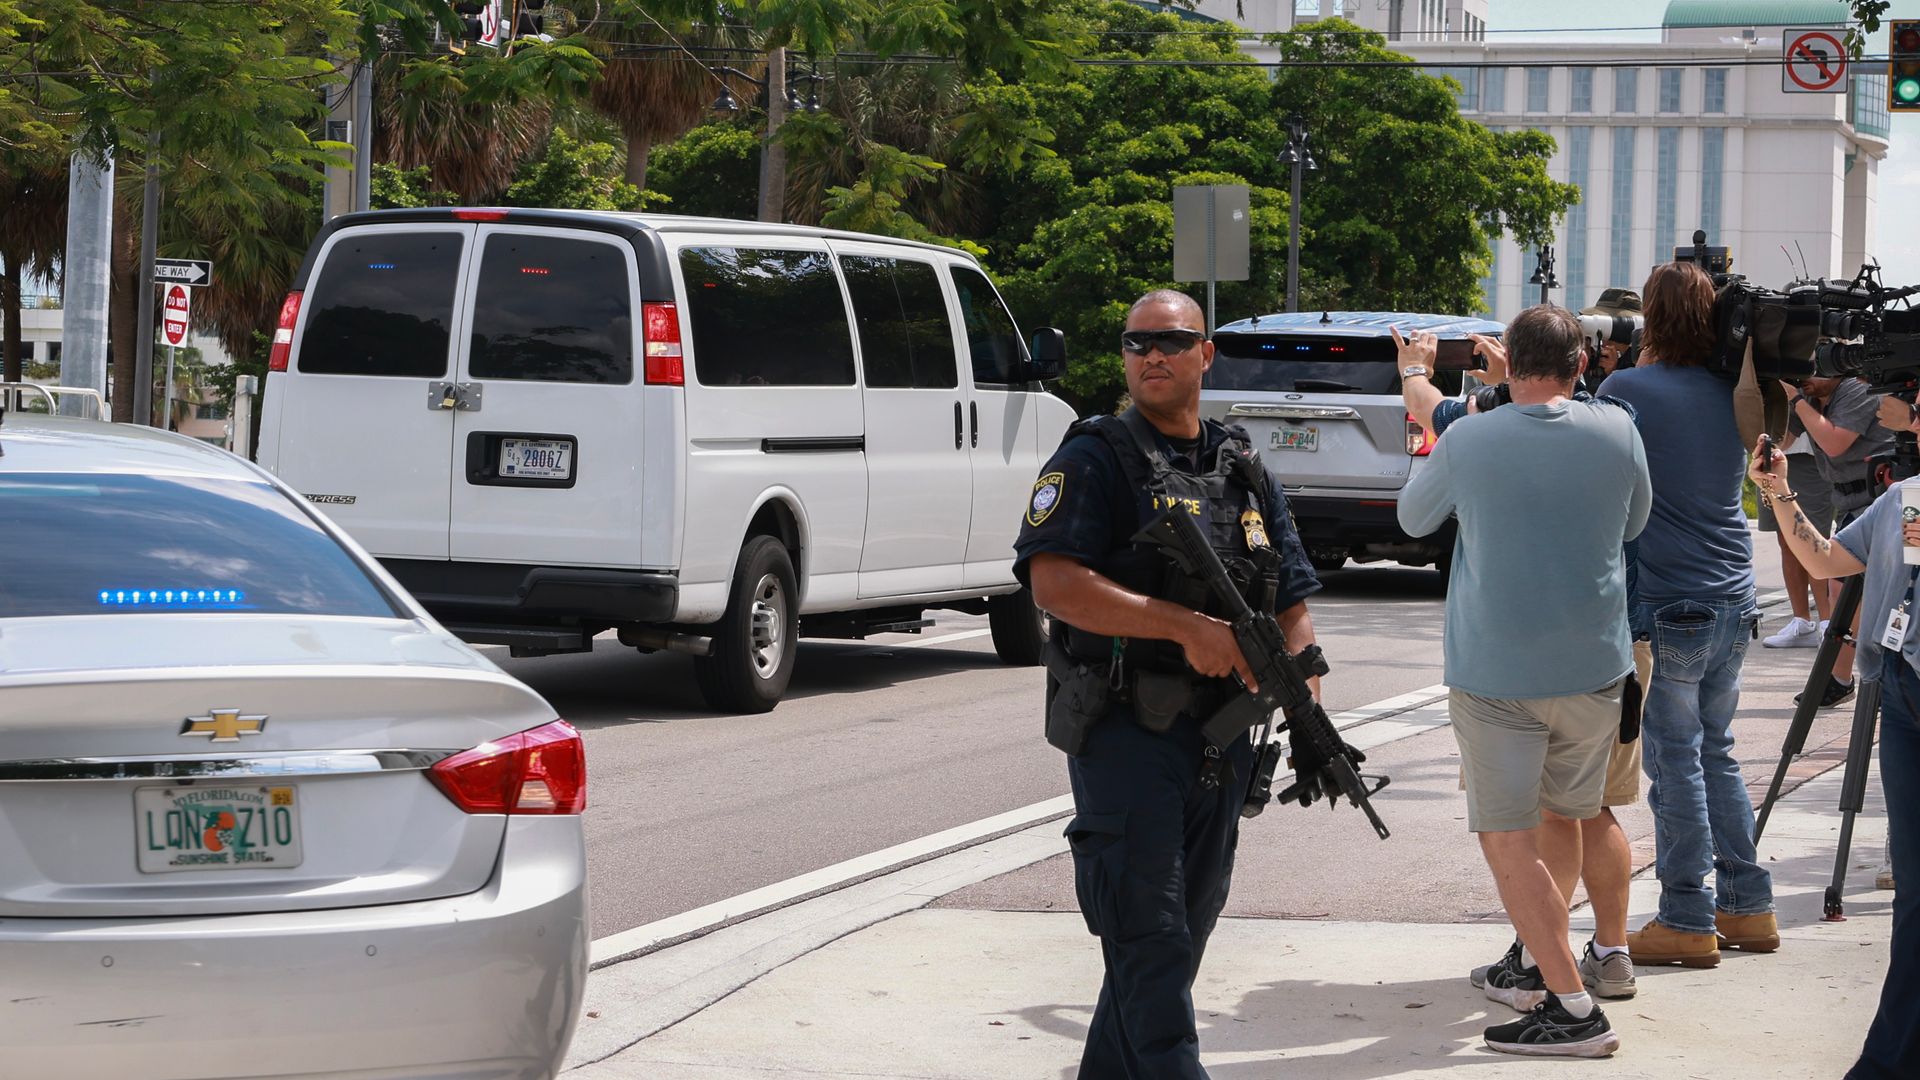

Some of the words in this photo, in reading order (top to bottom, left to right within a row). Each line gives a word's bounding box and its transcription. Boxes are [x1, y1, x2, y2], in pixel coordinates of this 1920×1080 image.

[155, 266, 167, 276] NE
[170, 267, 189, 277] WAY
[168, 296, 176, 306] DO
[176, 298, 186, 307] NOT
[168, 323, 182, 334] ENTER
[524, 450, 562, 468] 2806Z
[1035, 475, 1062, 491] POLICE
[305, 494, 355, 504] XPRESS
[113, 757, 331, 778] IMPLA
[147, 809, 201, 851] LQN
[237, 806, 292, 848] Z10
[176, 852, 230, 866] SUNSHINE
[233, 851, 267, 864] STATE
